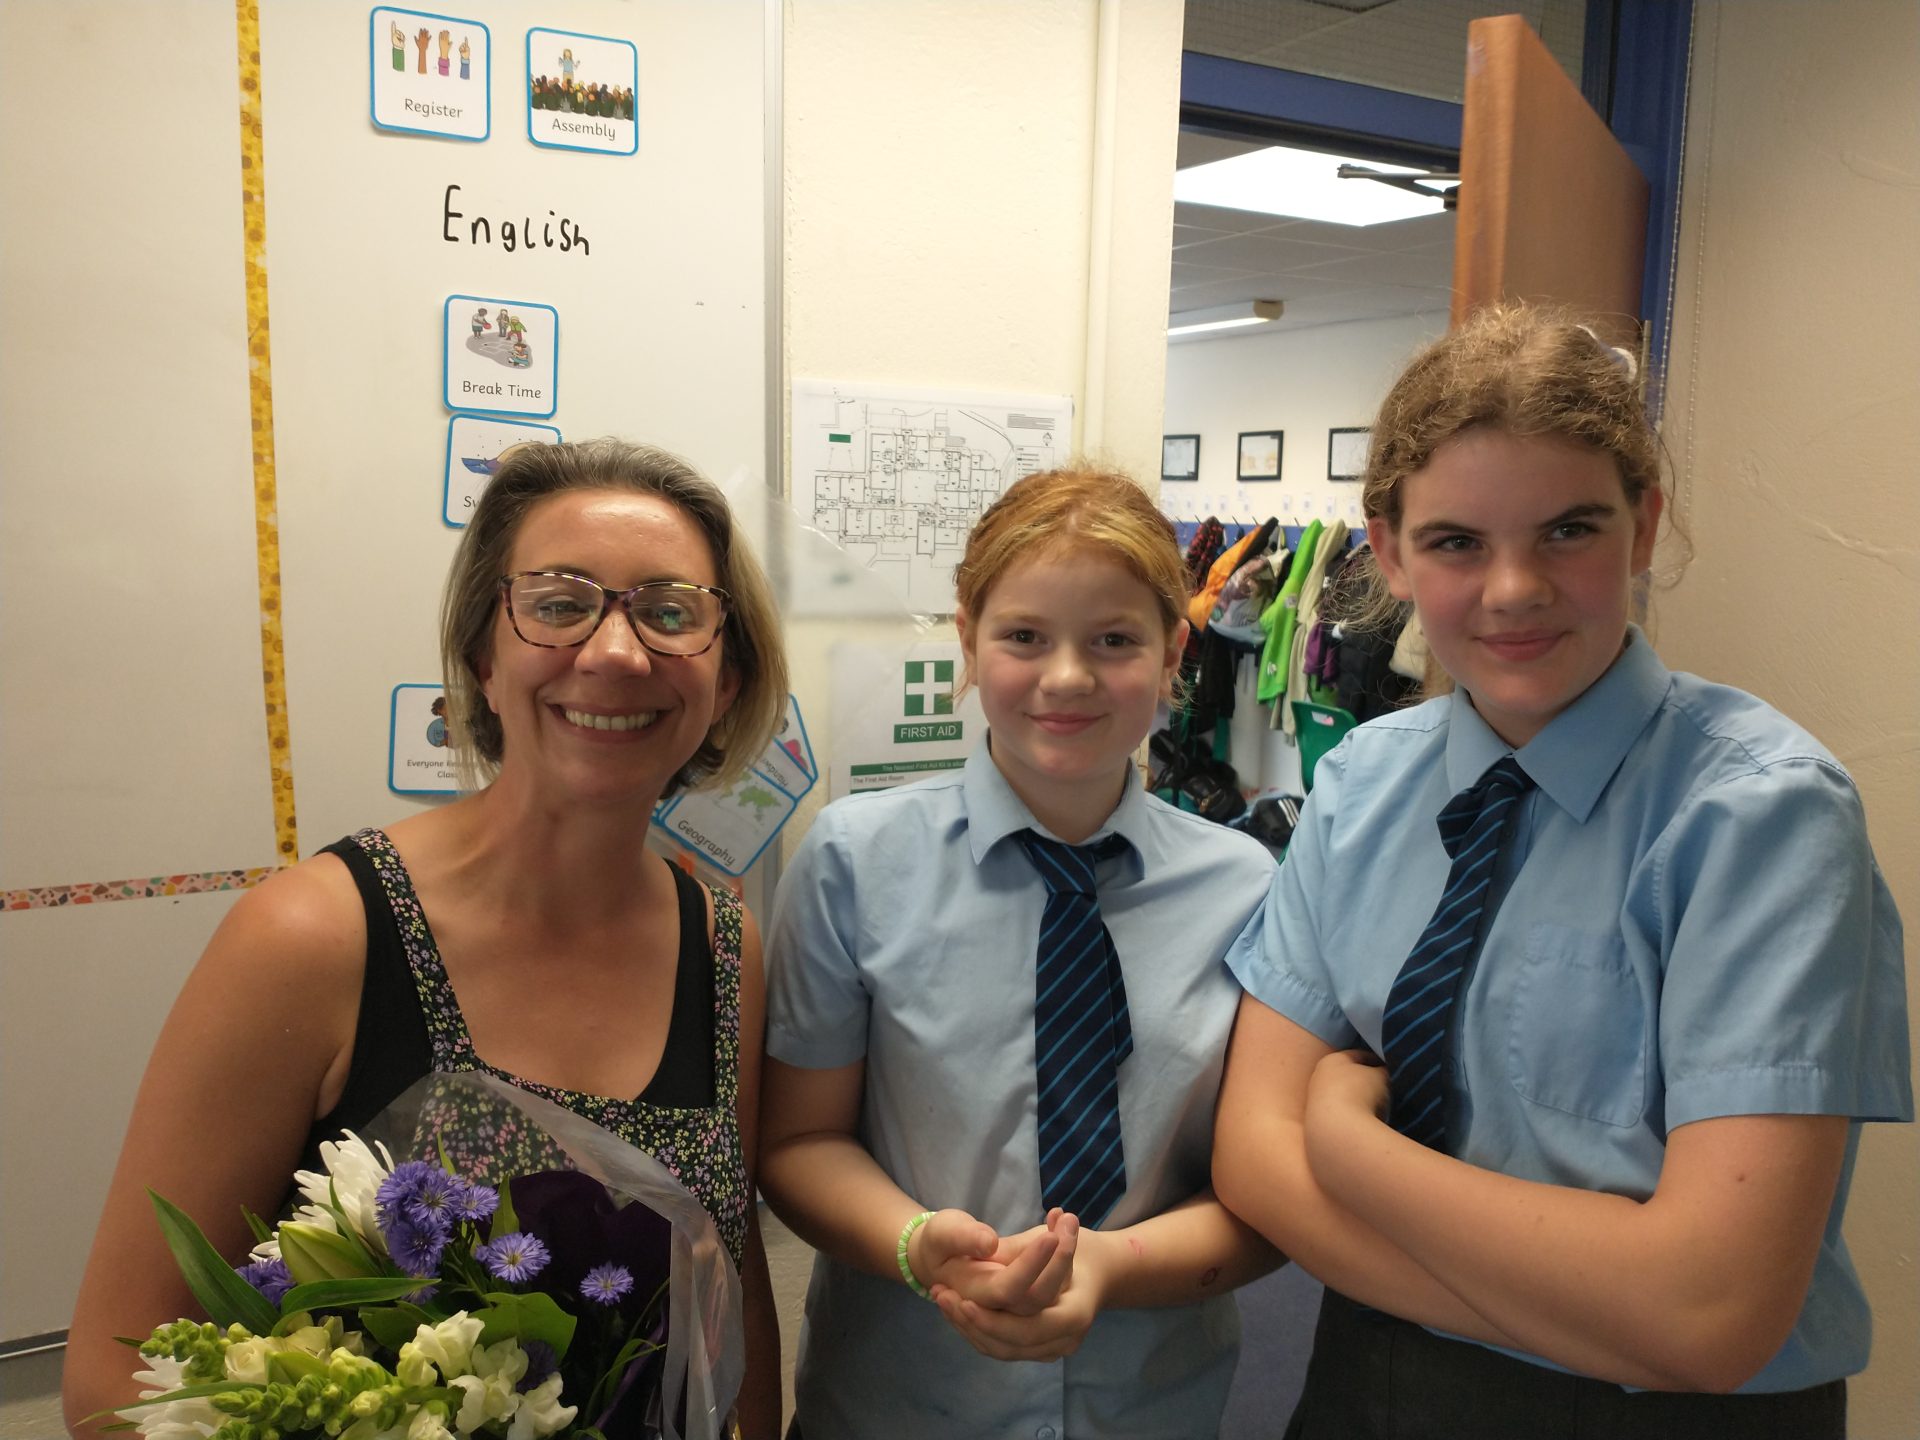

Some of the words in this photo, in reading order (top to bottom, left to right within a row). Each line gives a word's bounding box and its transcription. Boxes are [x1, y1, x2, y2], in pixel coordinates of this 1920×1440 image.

[404, 98, 463, 119] Register
[551, 118, 616, 141] Assembly
[443, 184, 590, 256] English
[462, 380, 503, 395] Break
[508, 384, 542, 399] Time
[900, 726, 935, 738] FIRST
[936, 725, 956, 736] AID
[407, 759, 444, 769] Everyone
[677, 819, 736, 867] Geography
